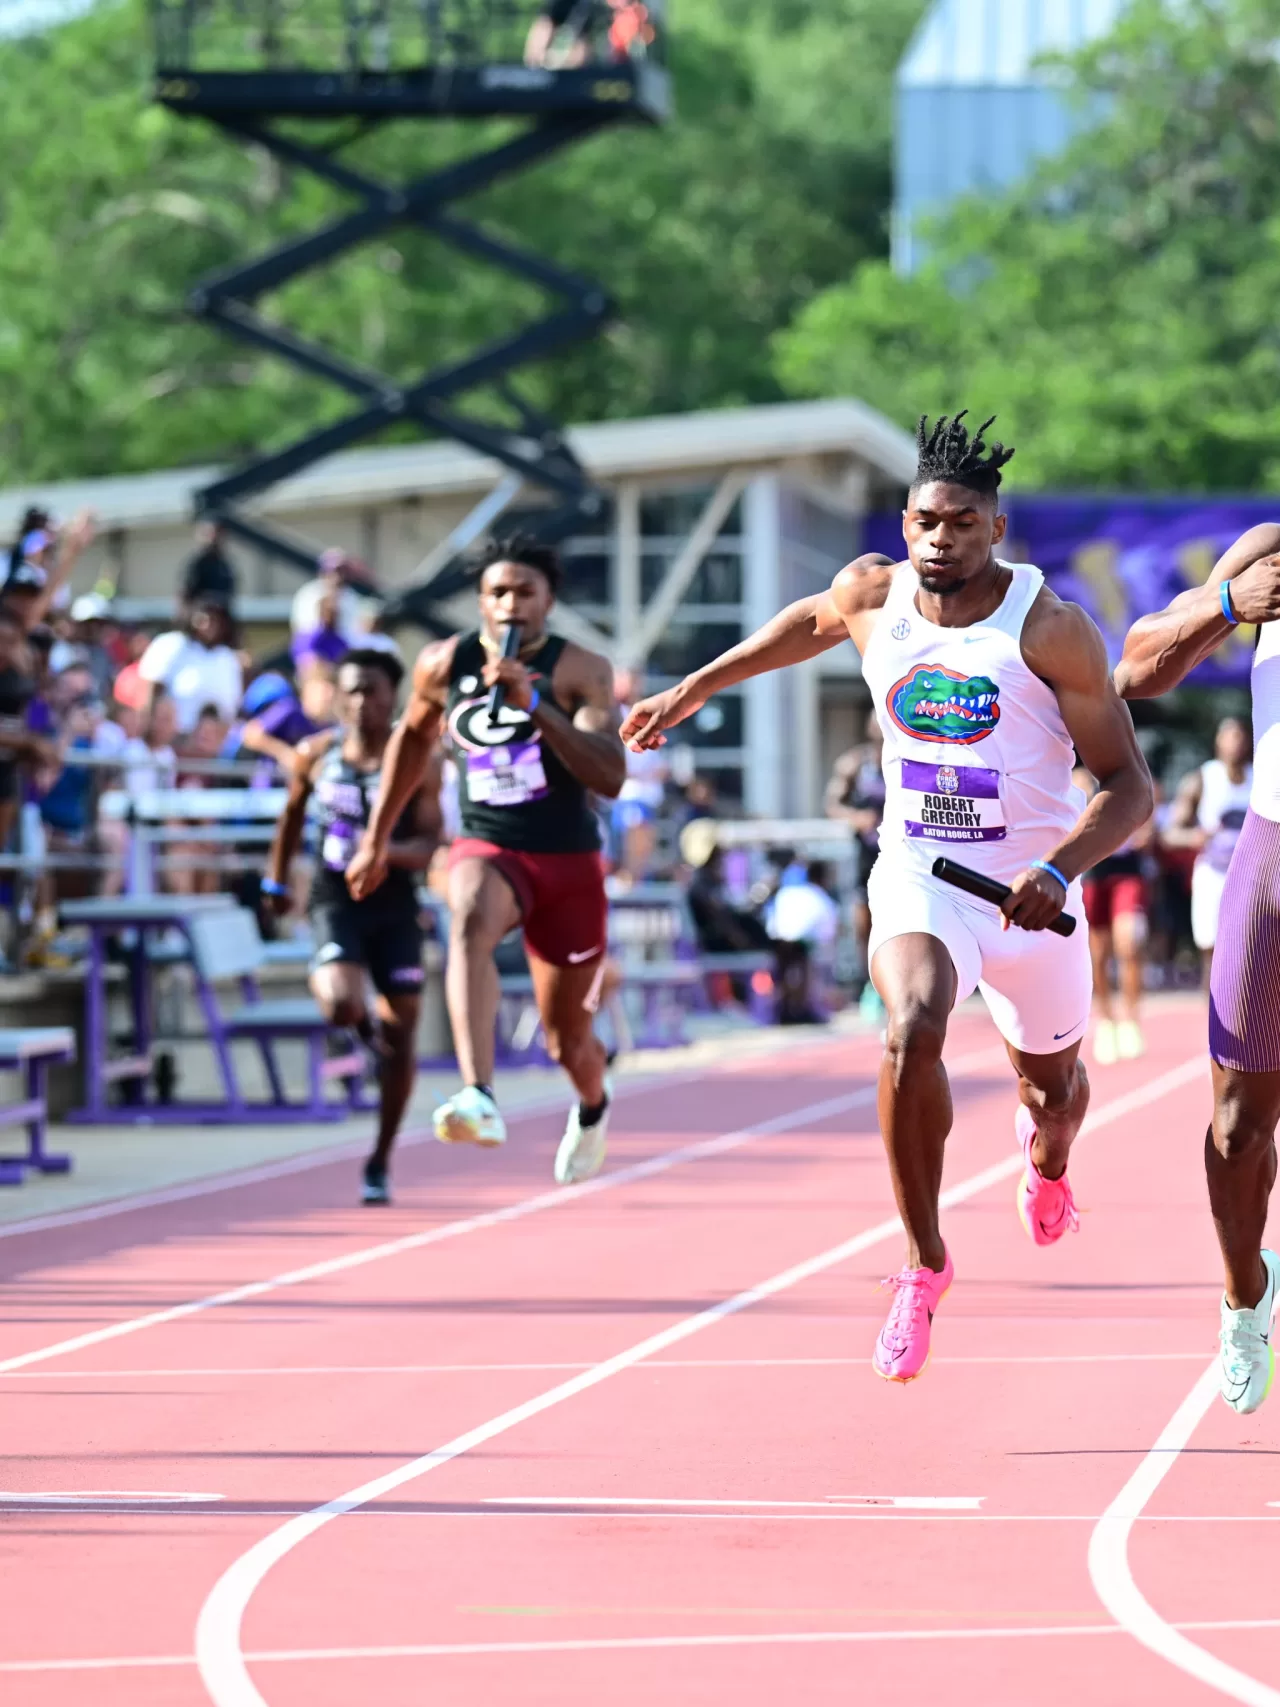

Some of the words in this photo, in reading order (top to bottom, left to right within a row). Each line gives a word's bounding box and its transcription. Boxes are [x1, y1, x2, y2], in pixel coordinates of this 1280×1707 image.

[923, 794, 975, 812] ROBERT
[921, 808, 981, 827] GREGORY
[923, 827, 946, 839] BATON
[974, 831, 984, 839] LA
